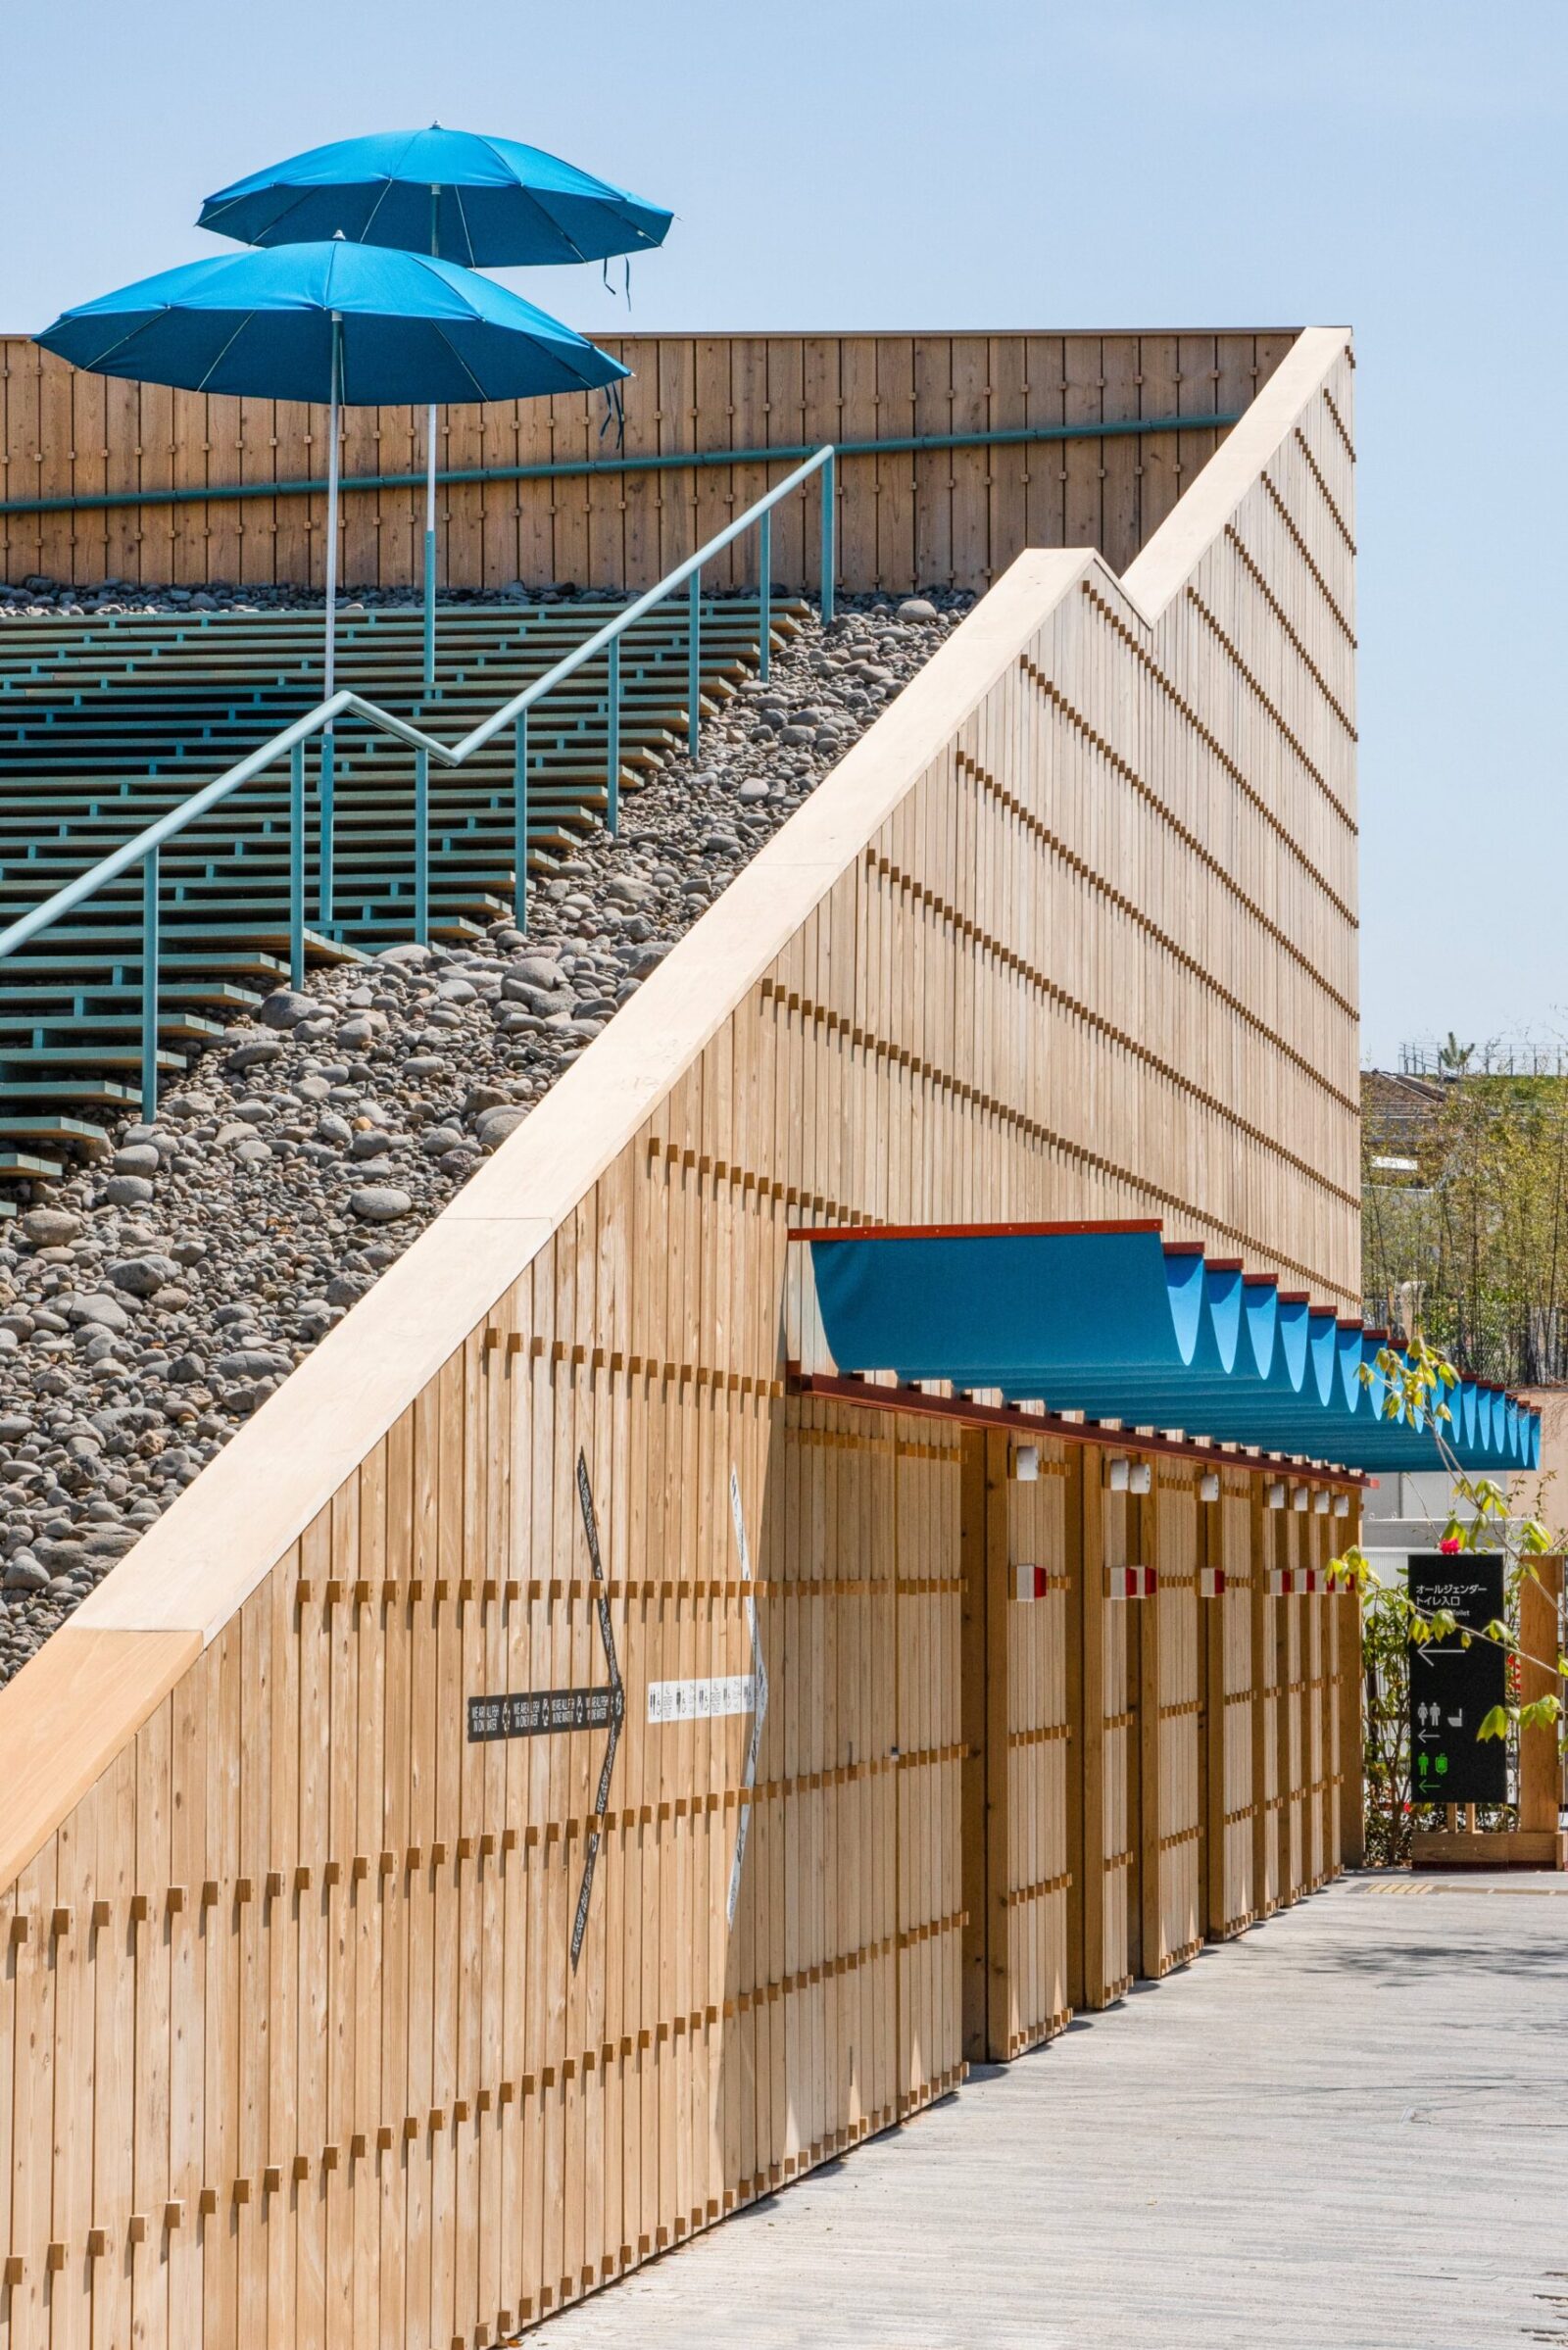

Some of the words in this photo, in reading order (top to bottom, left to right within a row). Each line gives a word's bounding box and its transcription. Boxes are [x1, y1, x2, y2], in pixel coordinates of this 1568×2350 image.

[1415, 1584, 1488, 1594] オールジェンダー
[1416, 1595, 1460, 1606] トイレ入口
